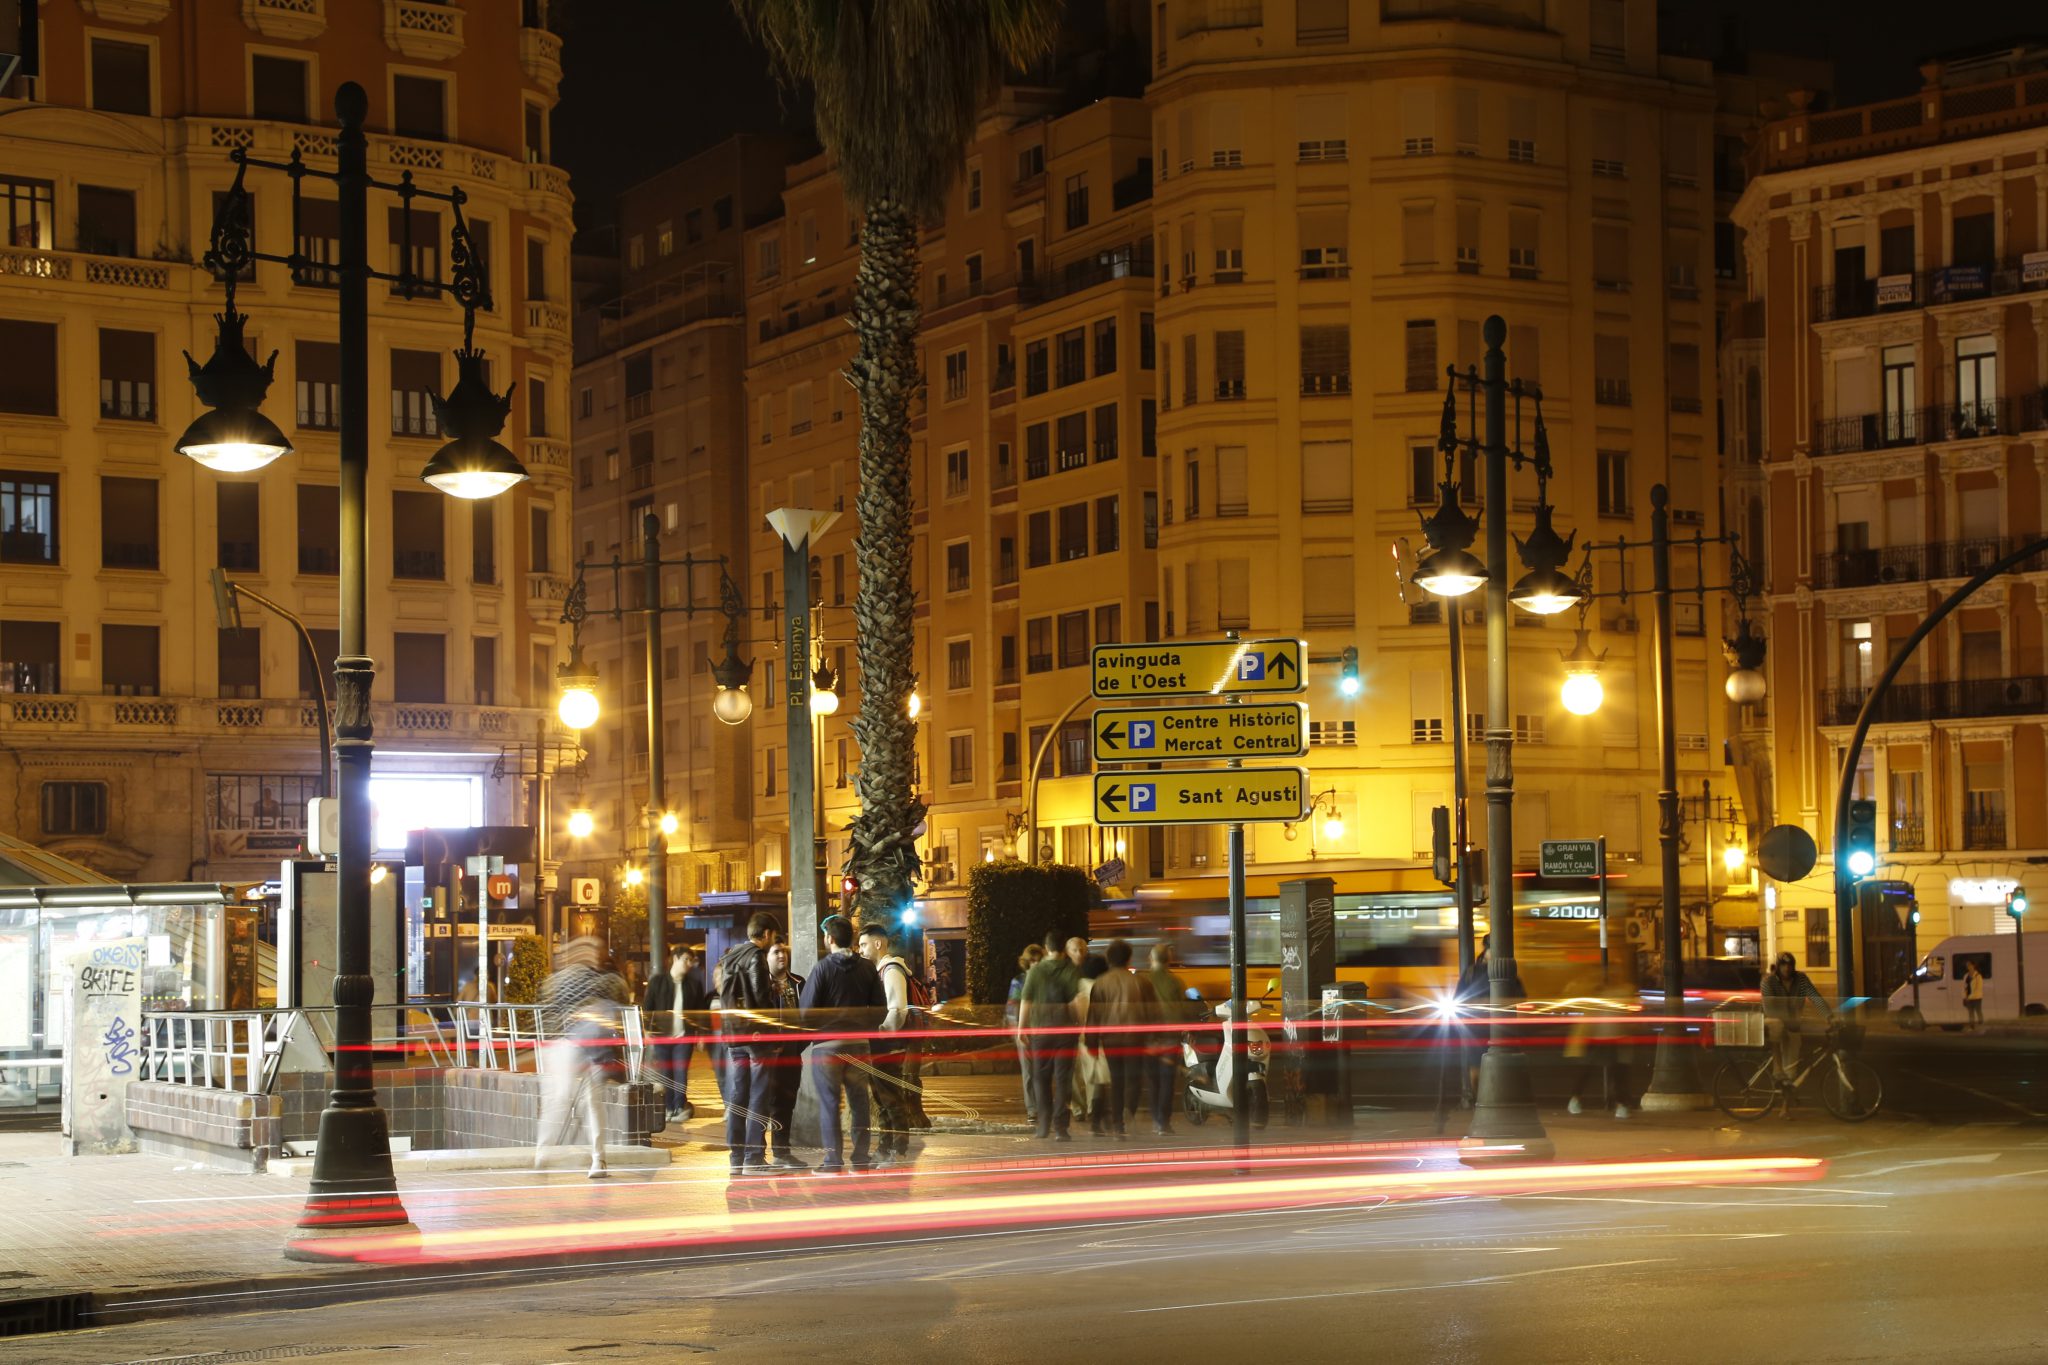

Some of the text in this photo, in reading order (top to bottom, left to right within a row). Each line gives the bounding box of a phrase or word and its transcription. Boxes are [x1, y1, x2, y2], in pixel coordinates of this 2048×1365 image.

[790, 616, 805, 706] Pl. Espanya
[1098, 652, 1181, 670] avinguda
[1241, 655, 1259, 680] P
[1098, 673, 1186, 690] de l'Oest
[1163, 712, 1296, 730] Centre Històric
[1133, 723, 1151, 746] P
[1165, 734, 1296, 751] Mercat Central
[1132, 786, 1297, 810] P Sant Agustí
[1557, 844, 1577, 852] GRAN
[1544, 861, 1567, 870] RAMÓN
